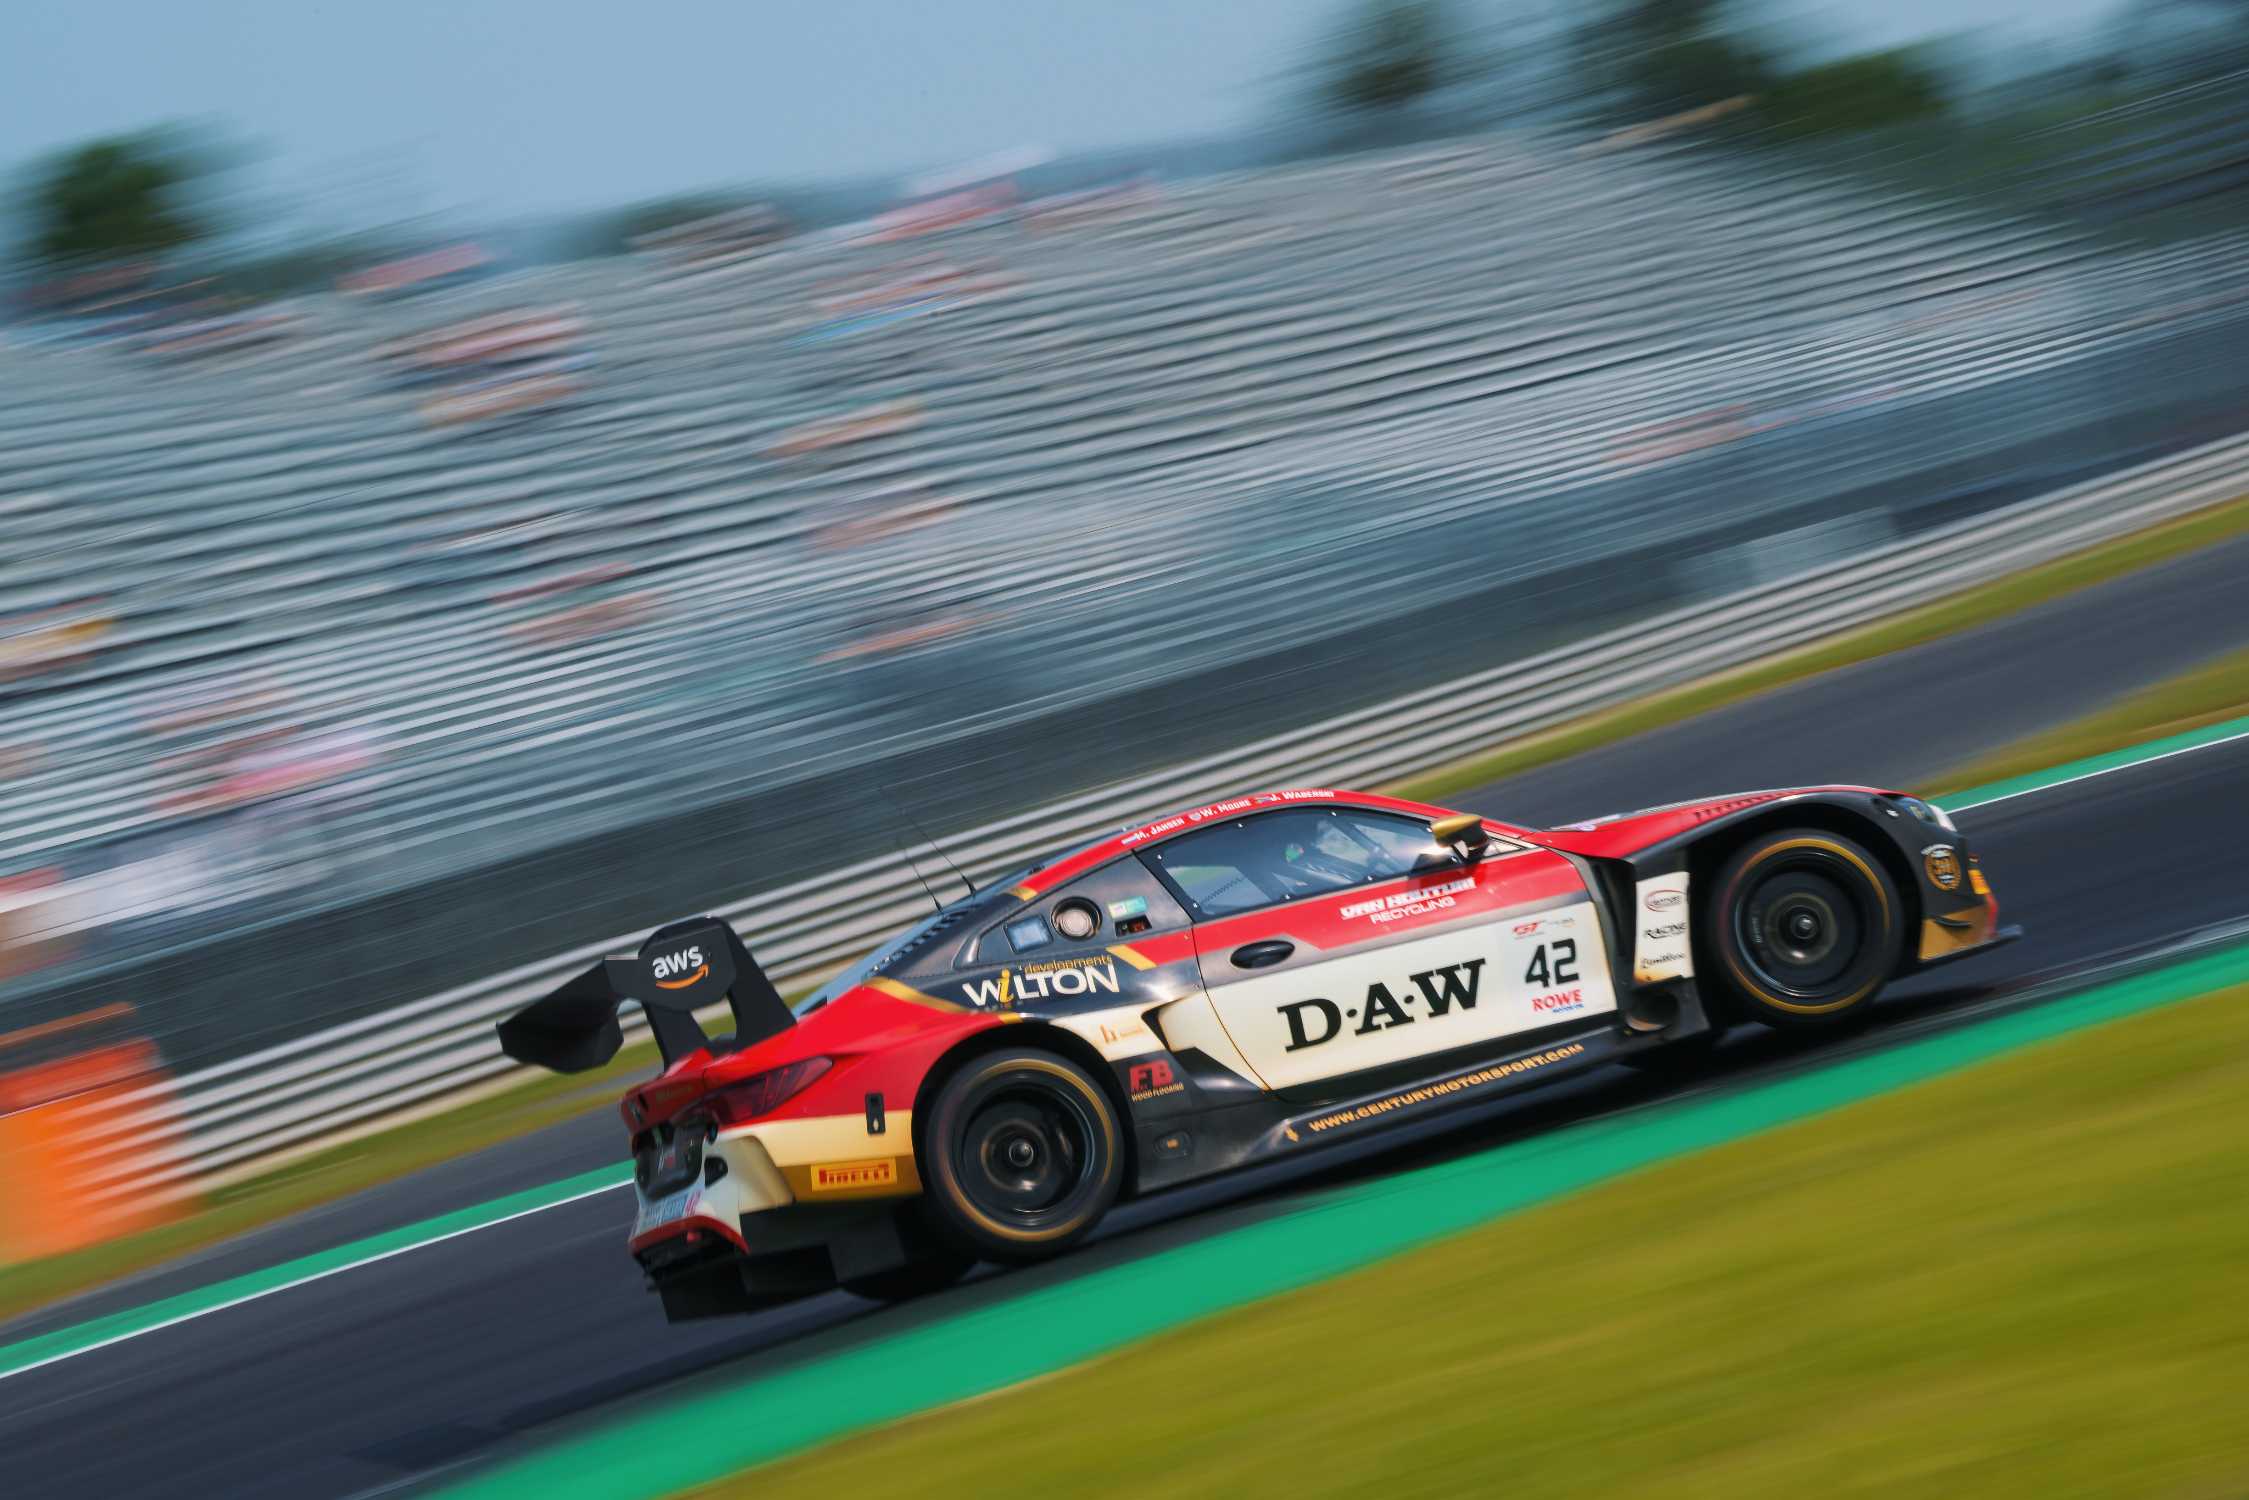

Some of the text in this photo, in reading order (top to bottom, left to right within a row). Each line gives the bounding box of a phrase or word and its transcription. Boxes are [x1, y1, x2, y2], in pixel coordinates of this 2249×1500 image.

[1201, 807, 1217, 818] W.
[1369, 895, 1457, 924] RECYCLING
[652, 945, 704, 979] aws
[1023, 954, 1112, 975] developments
[1525, 937, 1580, 989] 42
[1531, 988, 1583, 1012] ROWE
[1128, 1059, 1174, 1092] FB
[1308, 1043, 1586, 1133] WWW.CENTURYMOTORSPORT.COM
